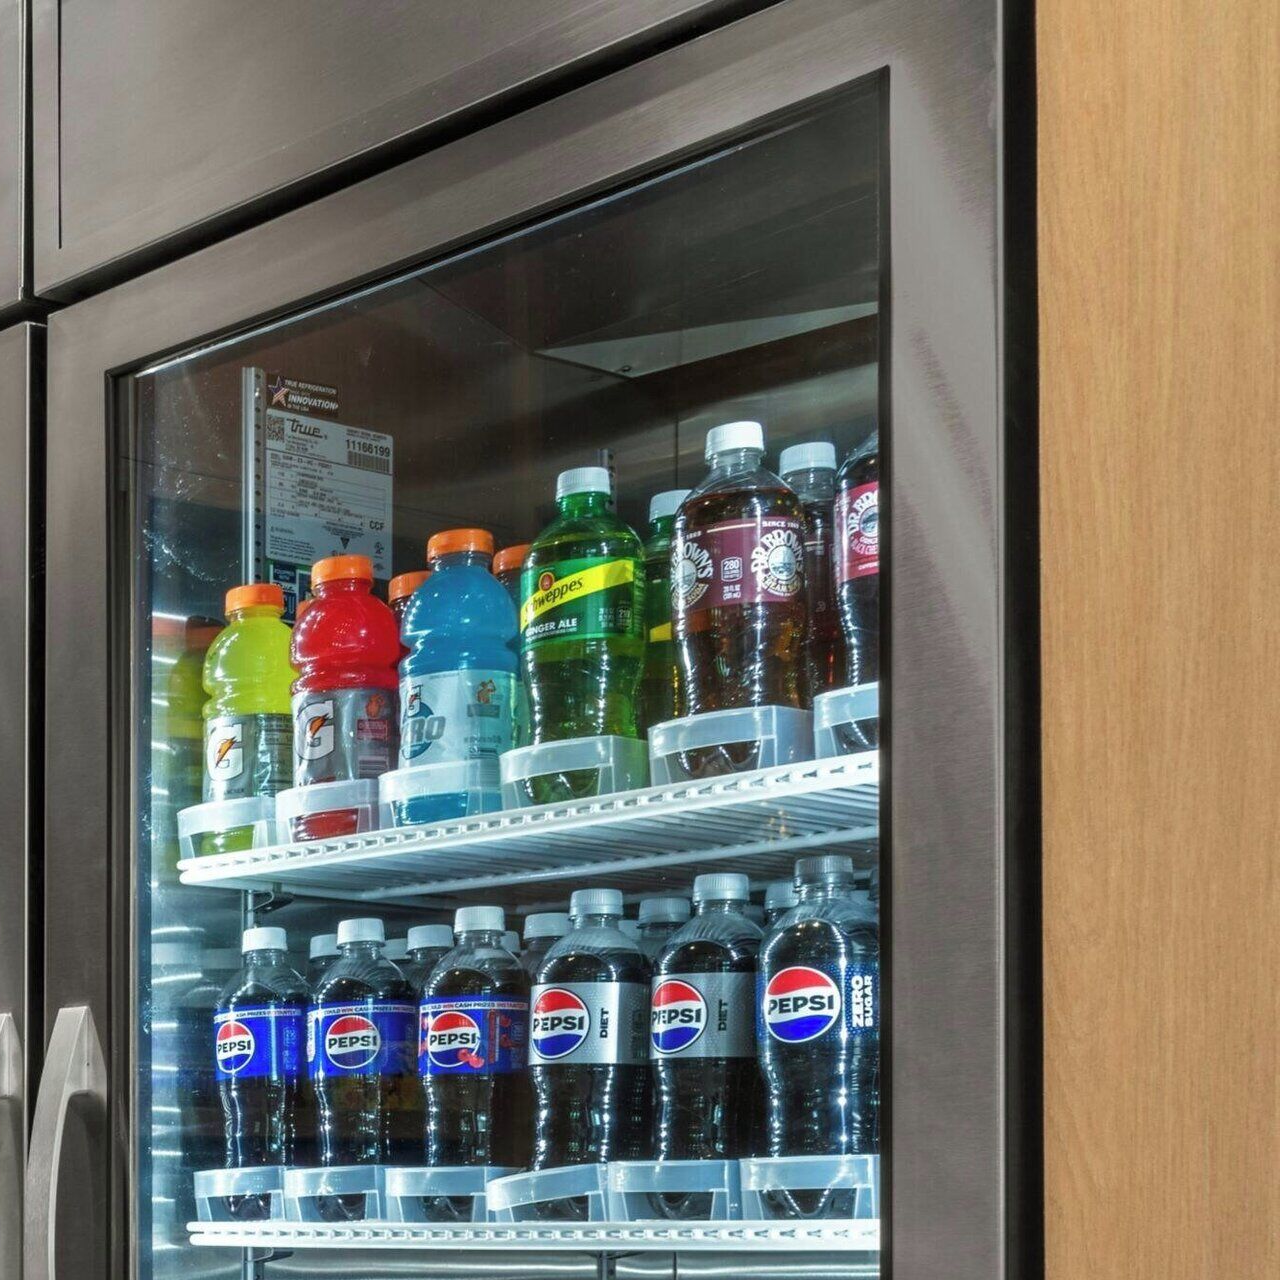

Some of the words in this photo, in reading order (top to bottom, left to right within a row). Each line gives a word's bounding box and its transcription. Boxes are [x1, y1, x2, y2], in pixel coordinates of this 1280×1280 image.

[345, 439, 390, 458] 11166199
[524, 577, 583, 616] Schweppes
[555, 618, 577, 630] ALE
[768, 995, 834, 1015] PEPSI
[851, 976, 863, 1028] ZERO
[533, 1008, 584, 1032] PEPSI
[600, 1008, 608, 1038] DIET
[651, 1008, 701, 1025] PEPSI
[718, 999, 726, 1031] DIET
[217, 1040, 251, 1054] PEPSI
[328, 1035, 377, 1048] PEPSI
[429, 1032, 477, 1046] PEPSI
